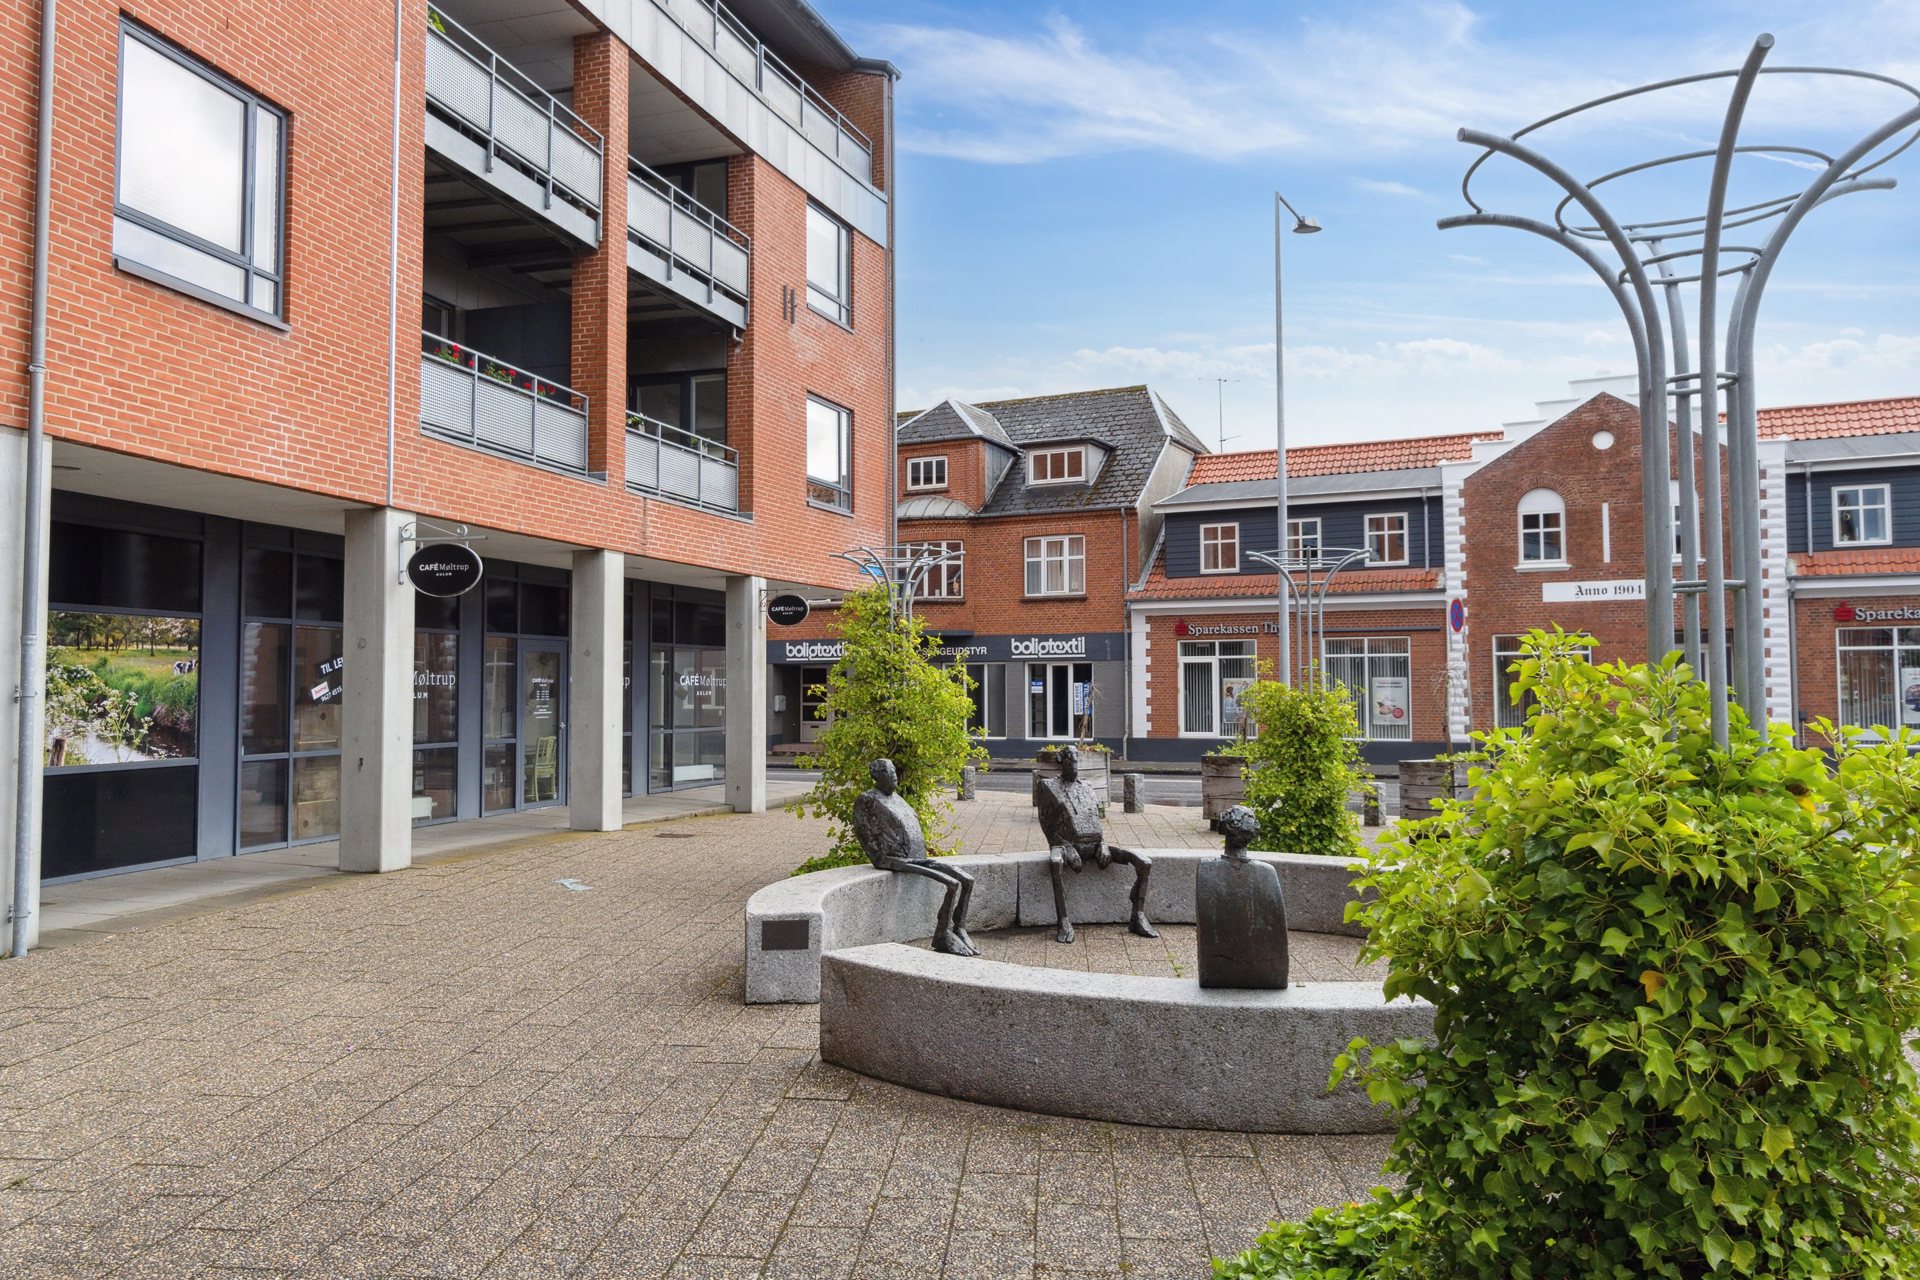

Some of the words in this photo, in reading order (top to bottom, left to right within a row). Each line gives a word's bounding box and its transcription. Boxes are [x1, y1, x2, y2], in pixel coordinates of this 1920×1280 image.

[419, 562, 439, 571] CAFÉ
[440, 563, 469, 572] Møltrup
[1574, 583, 1608, 599] Anno
[1188, 623, 1259, 636] Sparekassen
[1011, 636, 1086, 659] boligtextil
[321, 662, 333, 674] TIL
[680, 673, 699, 686] CAFÉ
